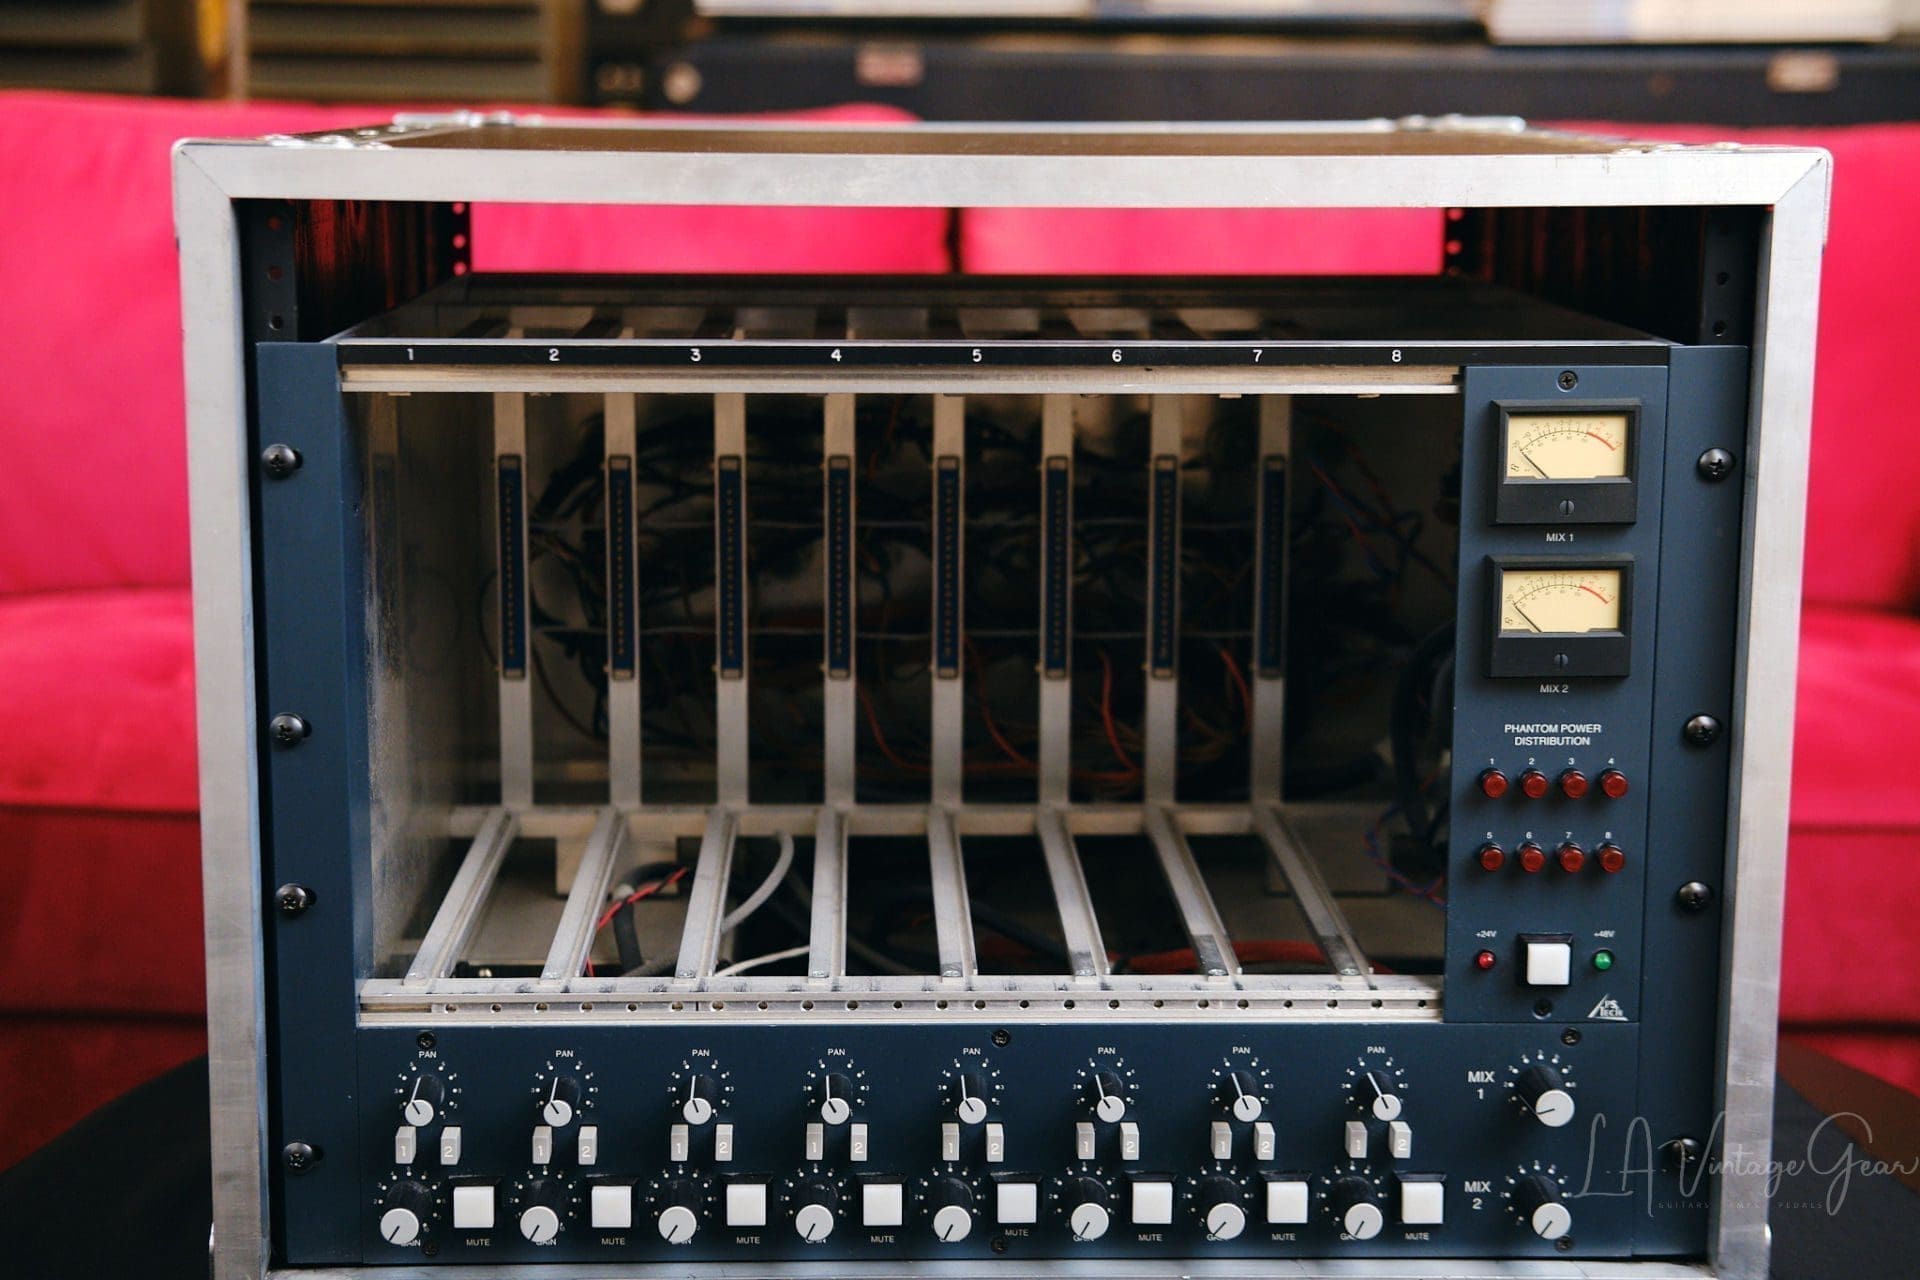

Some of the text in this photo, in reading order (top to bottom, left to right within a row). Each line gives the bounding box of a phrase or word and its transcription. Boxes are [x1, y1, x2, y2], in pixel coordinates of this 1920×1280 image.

[407, 348, 1402, 363] 1 2 3 4 5 6 7 8
[1546, 533, 1574, 542] MIX 1
[1539, 684, 1569, 694] MIX 2
[1504, 723, 1602, 734] PHANTOM POWER
[1514, 736, 1591, 746] DISTRIBUTION
[1489, 757, 1614, 765] 1 2 3 4
[1486, 831, 1612, 839] 5 6 7 8
[418, 1050, 437, 1059] PAN
[555, 1049, 574, 1058] PAN
[691, 1049, 710, 1057] PAN
[827, 1048, 846, 1056] PAN
[962, 1047, 981, 1055] PAN
[1097, 1047, 1116, 1055] PAN
[1232, 1046, 1251, 1054] PAN
[1367, 1046, 1386, 1054] PAN
[1467, 1070, 1495, 1083] MIX
[1477, 1088, 1484, 1100] 1
[676, 1143, 681, 1154] 1
[719, 1141, 729, 1154] 2
[812, 1142, 817, 1153] 1
[854, 1142, 864, 1154] 2
[948, 1142, 953, 1154] 1
[991, 1143, 1000, 1155] 2
[1083, 1141, 1089, 1153] 1
[1126, 1141, 1136, 1153] 2
[1220, 1141, 1226, 1153] 1
[1261, 1141, 1271, 1153] 2
[1398, 1138, 1407, 1151] 2
[400, 1145, 406, 1157] 1
[444, 1145, 454, 1158] 2
[537, 1145, 543, 1157] 1
[581, 1145, 592, 1158] 2
[1464, 1180, 1491, 1193] MIX
[1472, 1197, 1482, 1210] 2
[736, 1236, 760, 1244] MUTE
[870, 1235, 895, 1243] MUTE
[1271, 1233, 1296, 1241] MUTE
[1405, 1232, 1430, 1240] MUTE
